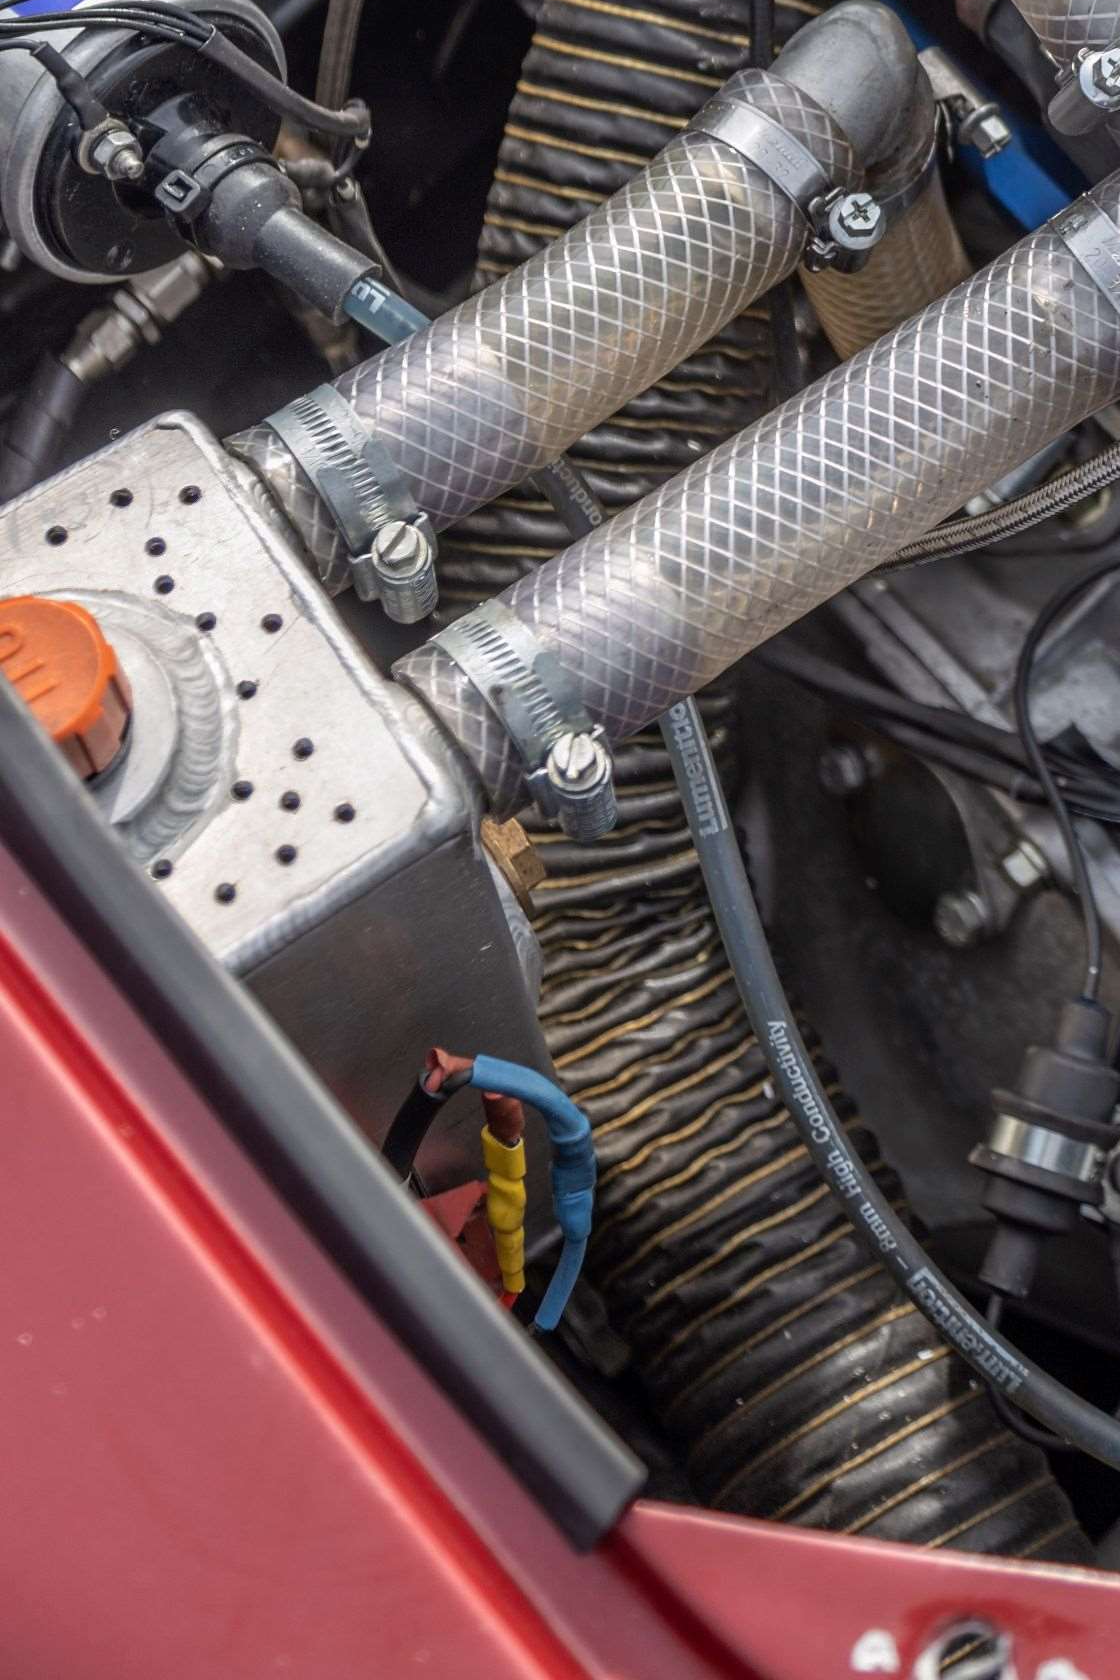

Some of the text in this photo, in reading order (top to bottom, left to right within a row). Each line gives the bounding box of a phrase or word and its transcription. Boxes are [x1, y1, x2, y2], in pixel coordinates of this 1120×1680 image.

[668, 701, 720, 838] Lumenitio
[767, 1020, 832, 1144] Conductivity
[827, 1148, 862, 1199] High
[859, 1201, 897, 1252] 8mm
